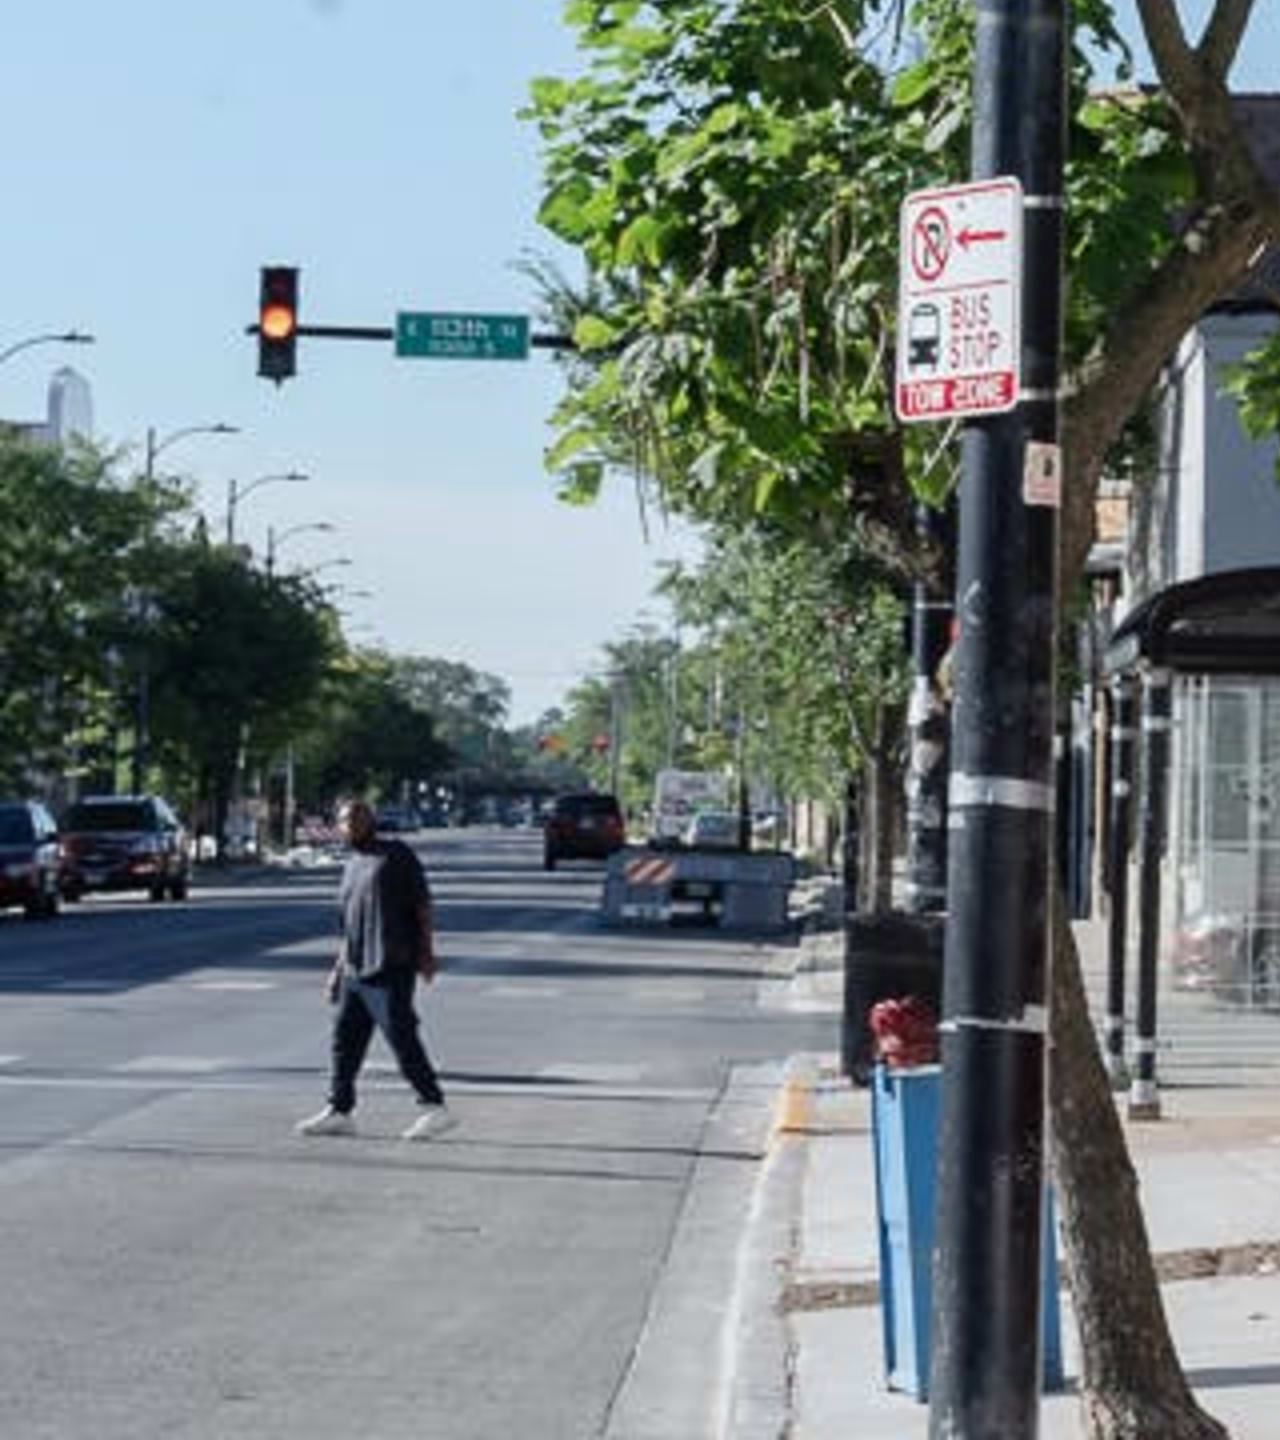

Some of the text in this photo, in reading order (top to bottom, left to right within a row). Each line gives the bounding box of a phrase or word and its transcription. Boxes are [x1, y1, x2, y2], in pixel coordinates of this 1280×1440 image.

[950, 293, 991, 331] BUS
[950, 329, 1001, 370] STOP
[905, 371, 1009, 416] TOW ZONE
